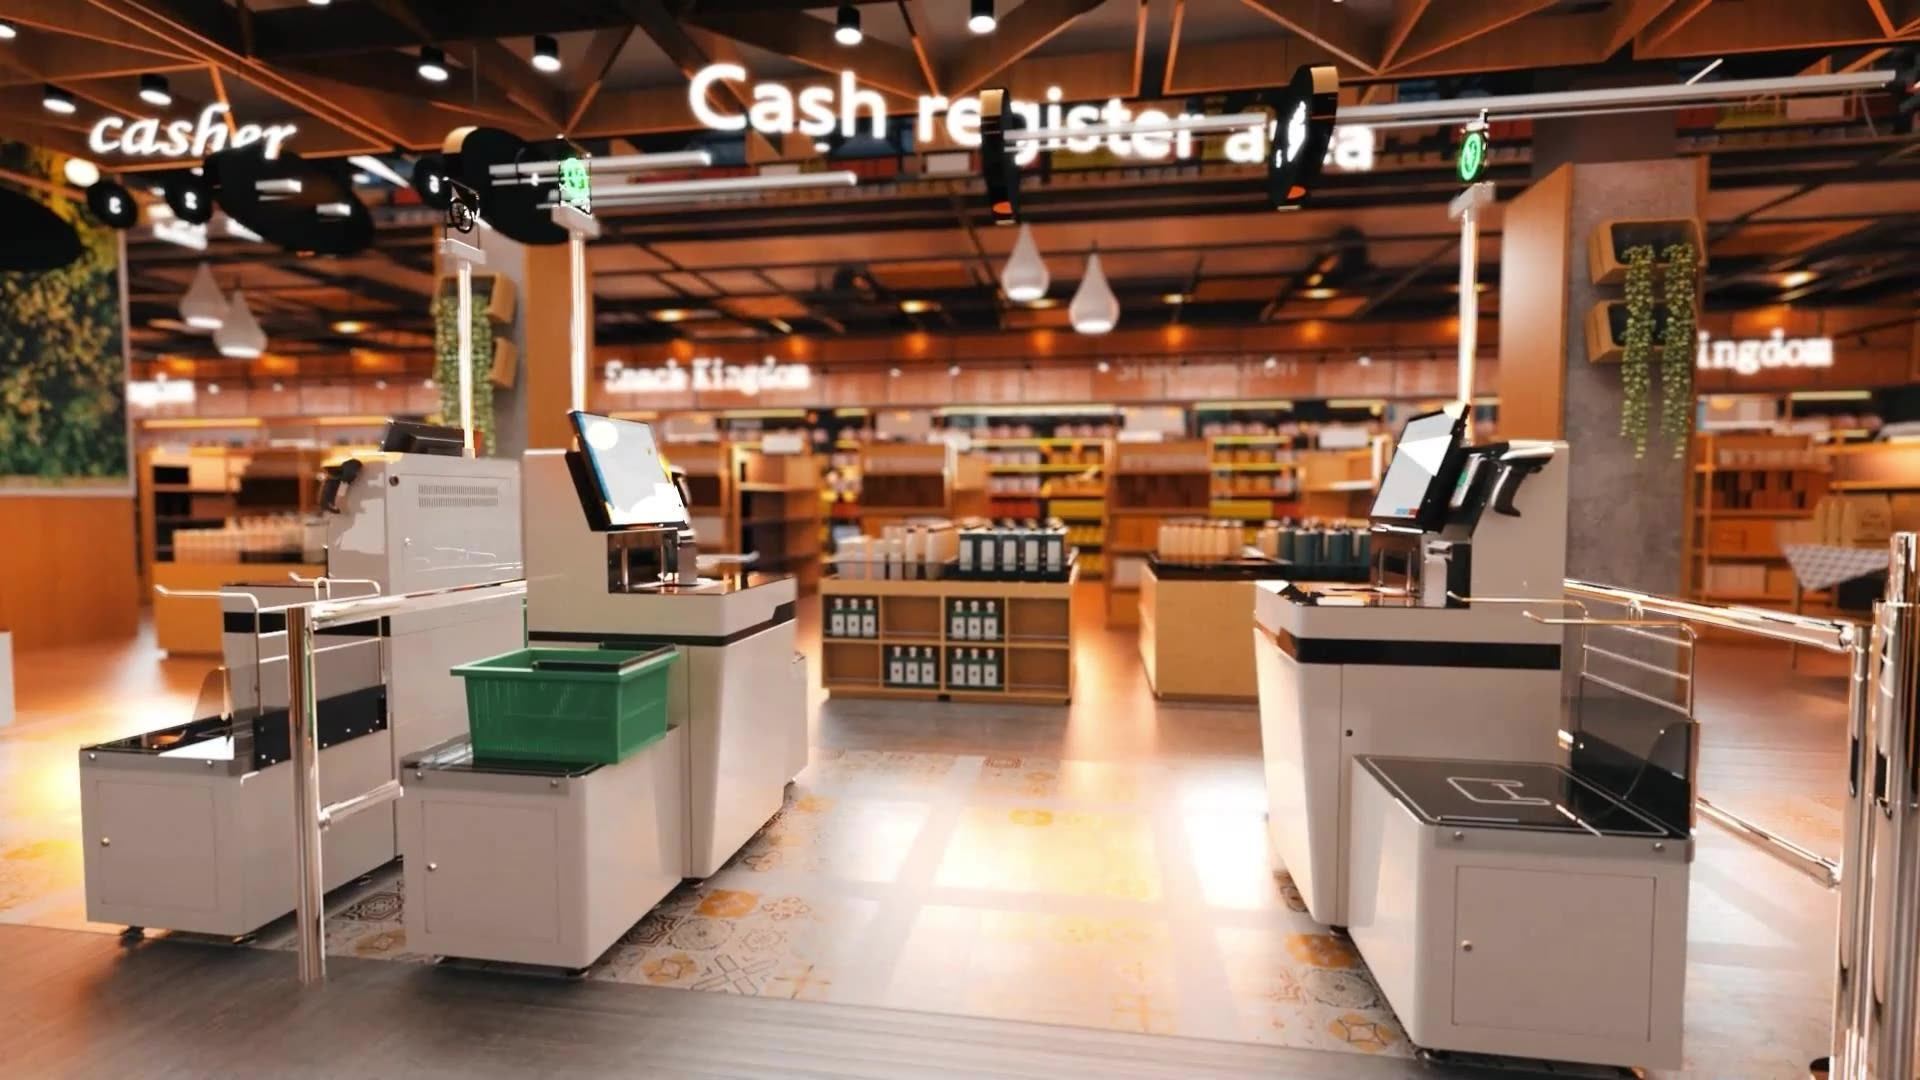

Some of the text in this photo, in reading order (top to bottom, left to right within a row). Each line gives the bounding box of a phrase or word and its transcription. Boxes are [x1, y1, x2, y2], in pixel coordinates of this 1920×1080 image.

[89, 103, 297, 160] casher
[688, 64, 886, 140] Cash
[916, 86, 1205, 166] register
[1224, 122, 1375, 172] aa
[1697, 328, 1833, 375] ingdom
